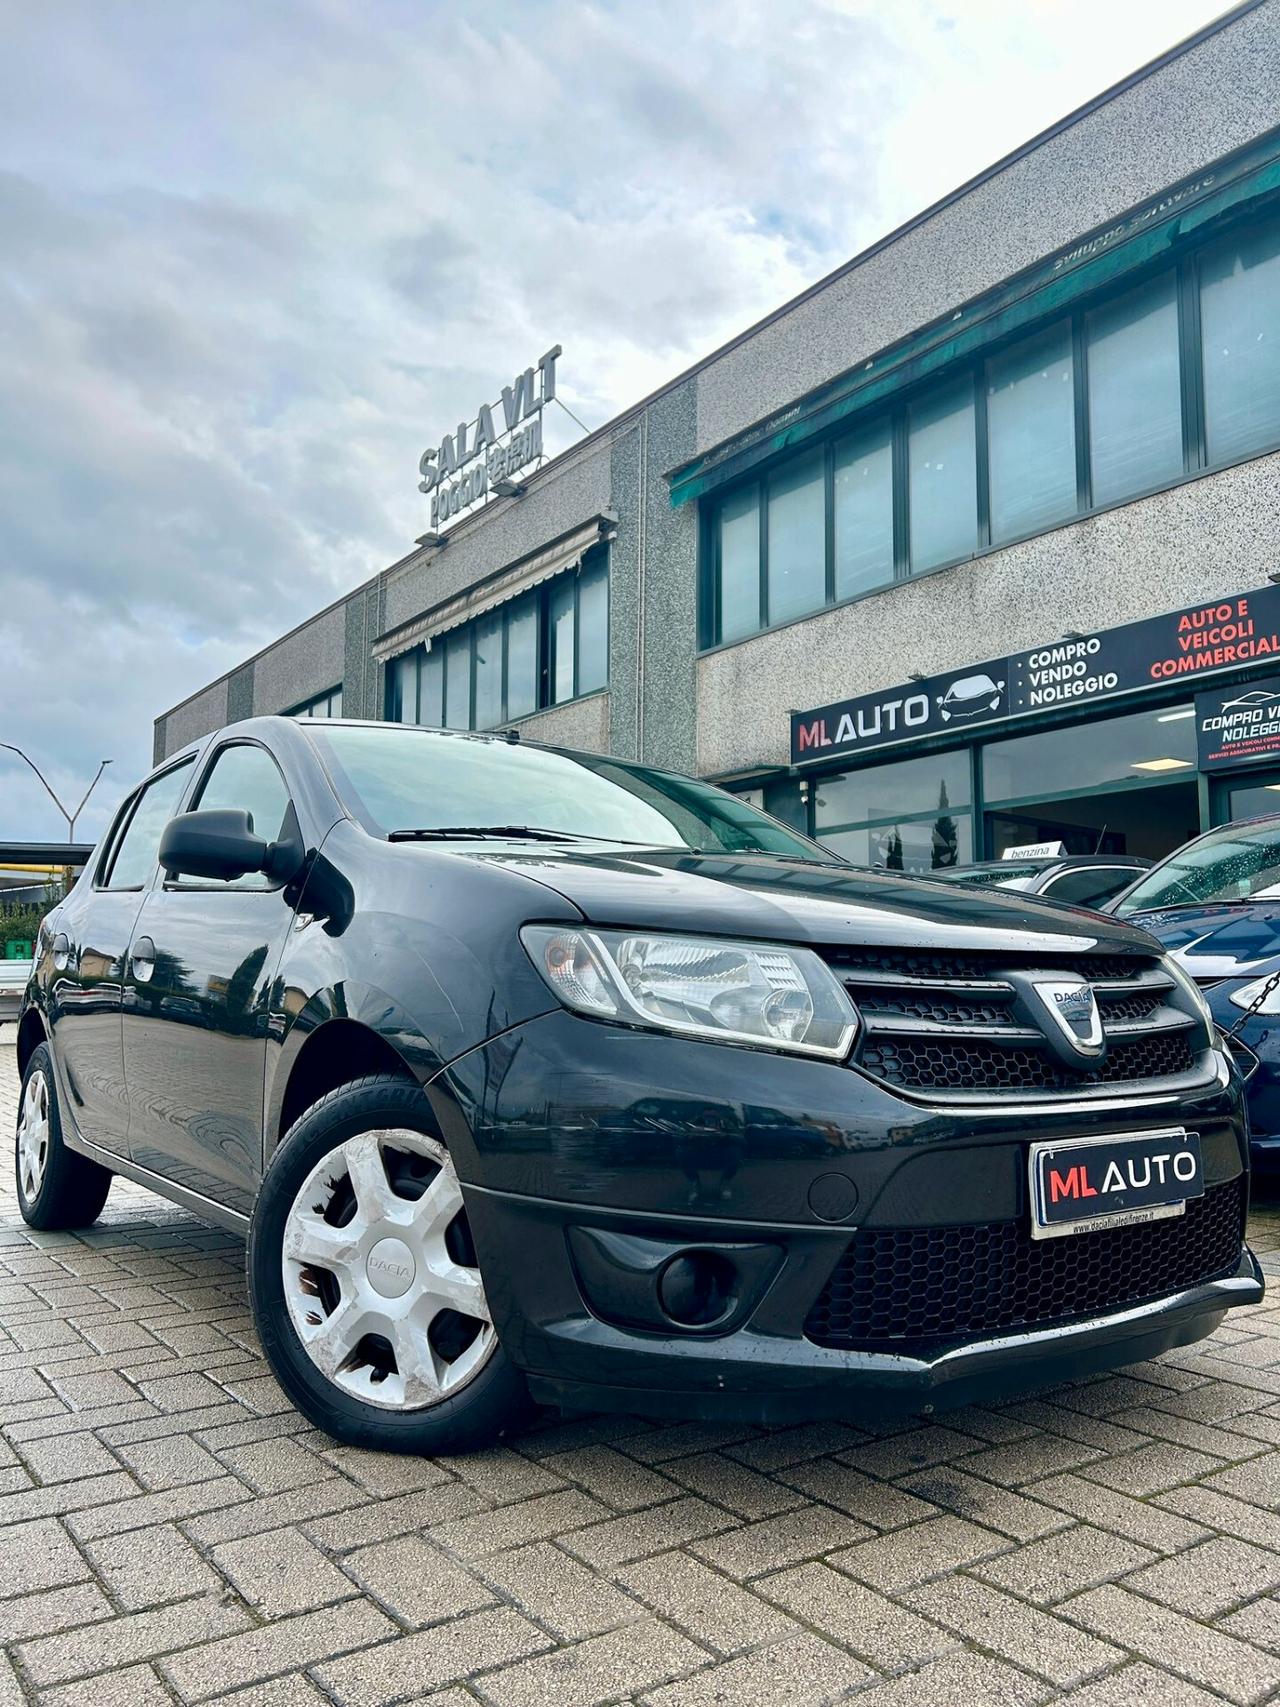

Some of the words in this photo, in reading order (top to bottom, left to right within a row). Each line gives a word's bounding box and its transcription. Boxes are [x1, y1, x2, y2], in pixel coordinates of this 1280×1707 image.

[418, 404, 496, 493] SALA
[501, 344, 563, 431] VLT
[431, 464, 487, 528] POGGIO
[1178, 604, 1233, 633] AUTO
[1237, 599, 1249, 617] E
[1178, 619, 1254, 652] VEICOLI
[1029, 638, 1101, 669] COMPRO
[1150, 635, 1280, 679] COMMERCIAL
[1029, 661, 1087, 687] VENDO
[1030, 672, 1118, 706] NOLEGGIO
[1202, 708, 1263, 732] COMPRO
[1208, 752, 1229, 760] SERVIZI
[1221, 742, 1236, 751] AUTO
[1241, 737, 1262, 747] VEICOLI
[1053, 992, 1089, 1004] DACIA
[369, 1256, 411, 1279] DACIA
